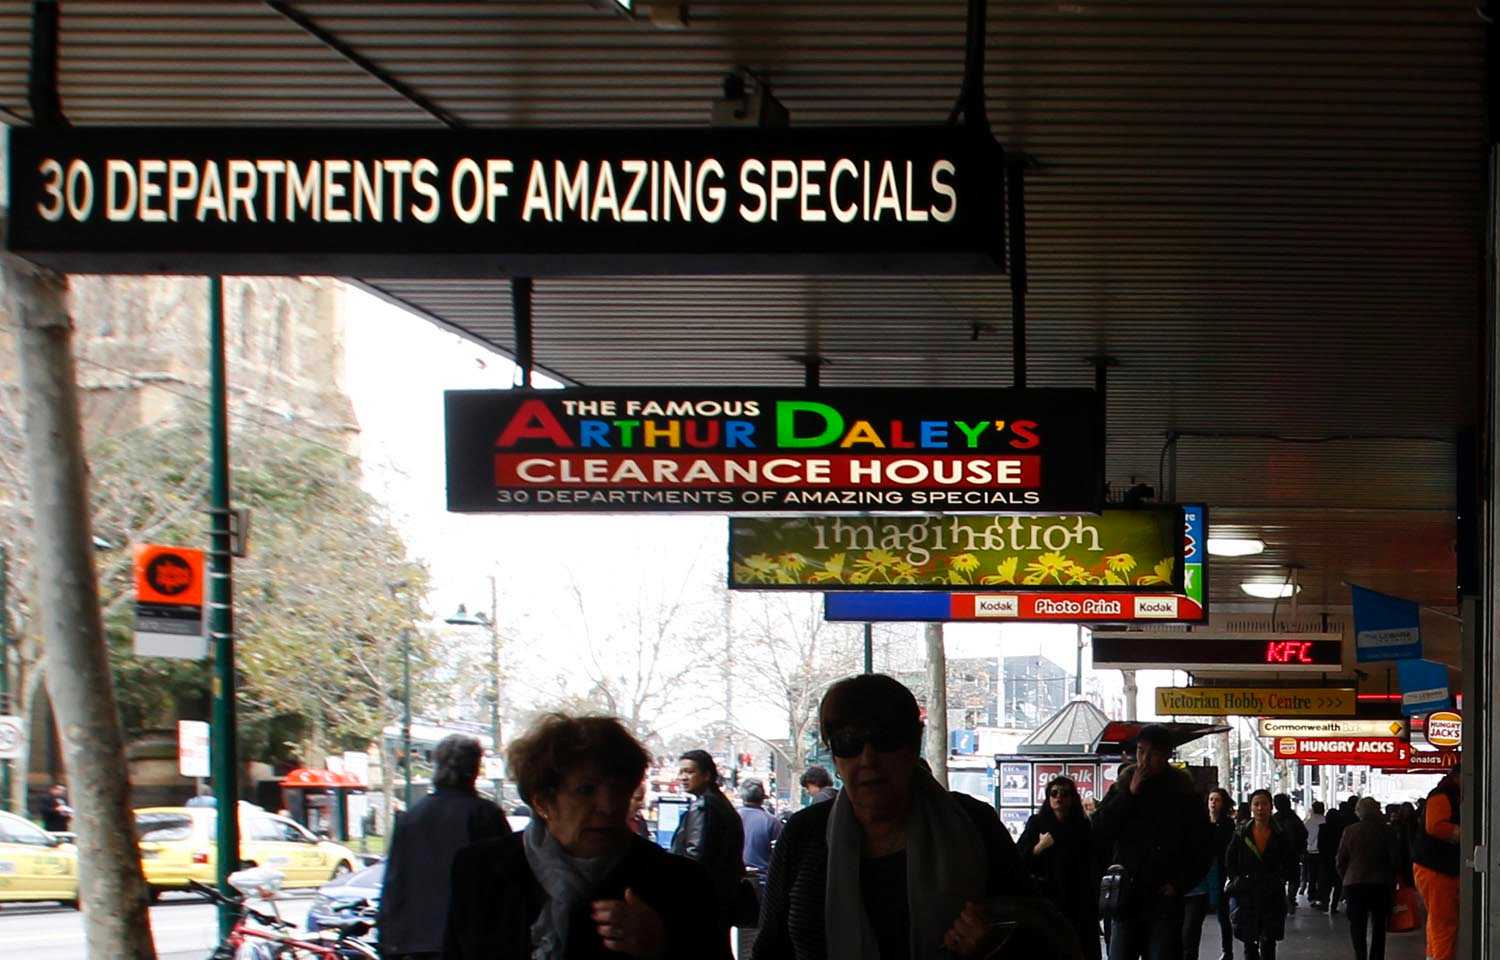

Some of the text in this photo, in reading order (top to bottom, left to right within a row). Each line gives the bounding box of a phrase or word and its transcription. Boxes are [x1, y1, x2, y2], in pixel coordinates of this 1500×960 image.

[39, 158, 957, 223] 30 DEPARTMENTS OF AMAZING SPECIALS
[562, 400, 761, 417] THE FAMOUS
[497, 400, 1040, 449] ARTHUR DALEY'S
[516, 458, 1021, 484] CLEARANCE HOUSE
[497, 490, 1040, 505] 30 DEPARTMENTS OF AMAZING SPECIALS
[980, 601, 1013, 612] Kodak
[1035, 598, 1121, 615] Photo Print
[1139, 601, 1173, 612] Kodak
[1266, 641, 1313, 663] KFC
[1161, 691, 1311, 713] Victorian Hobby Centre
[1265, 722, 1341, 732] Commonwealth
[1300, 741, 1354, 753] HUNGRY
